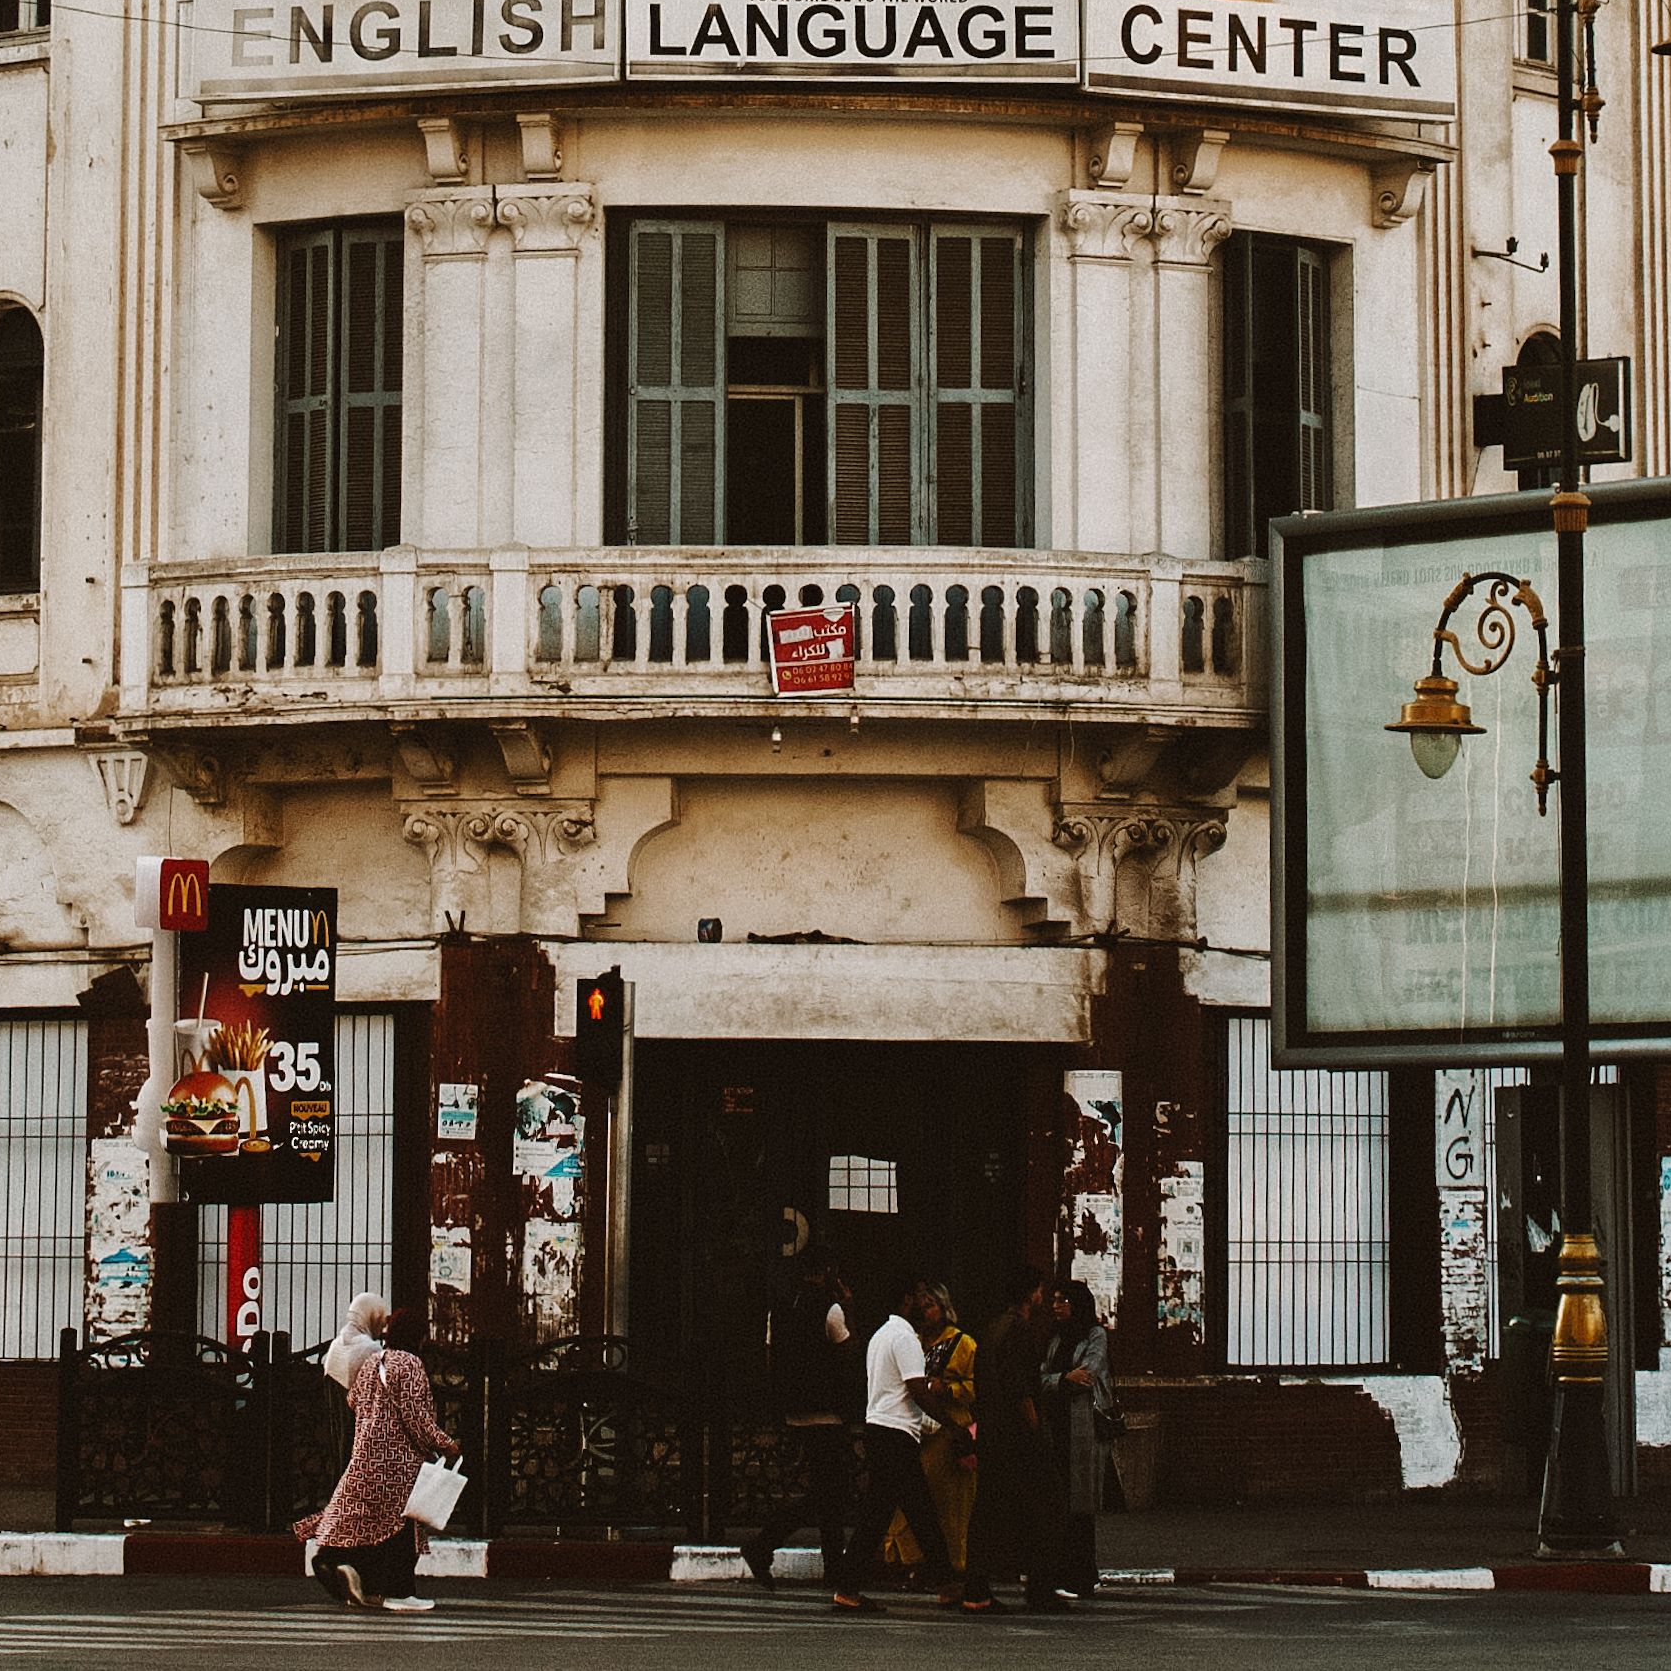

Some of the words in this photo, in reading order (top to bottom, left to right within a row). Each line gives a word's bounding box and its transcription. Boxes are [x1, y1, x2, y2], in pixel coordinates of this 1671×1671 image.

[648, 3, 1056, 60] LANGUAGE
[1119, 3, 1423, 88] CENTER
[814, 624, 846, 640] مكتب
[238, 943, 330, 997] مبروك
[269, 1041, 321, 1093] 35
[291, 1137, 330, 1151] Creamy
[307, 1121, 331, 1137] Spicy
